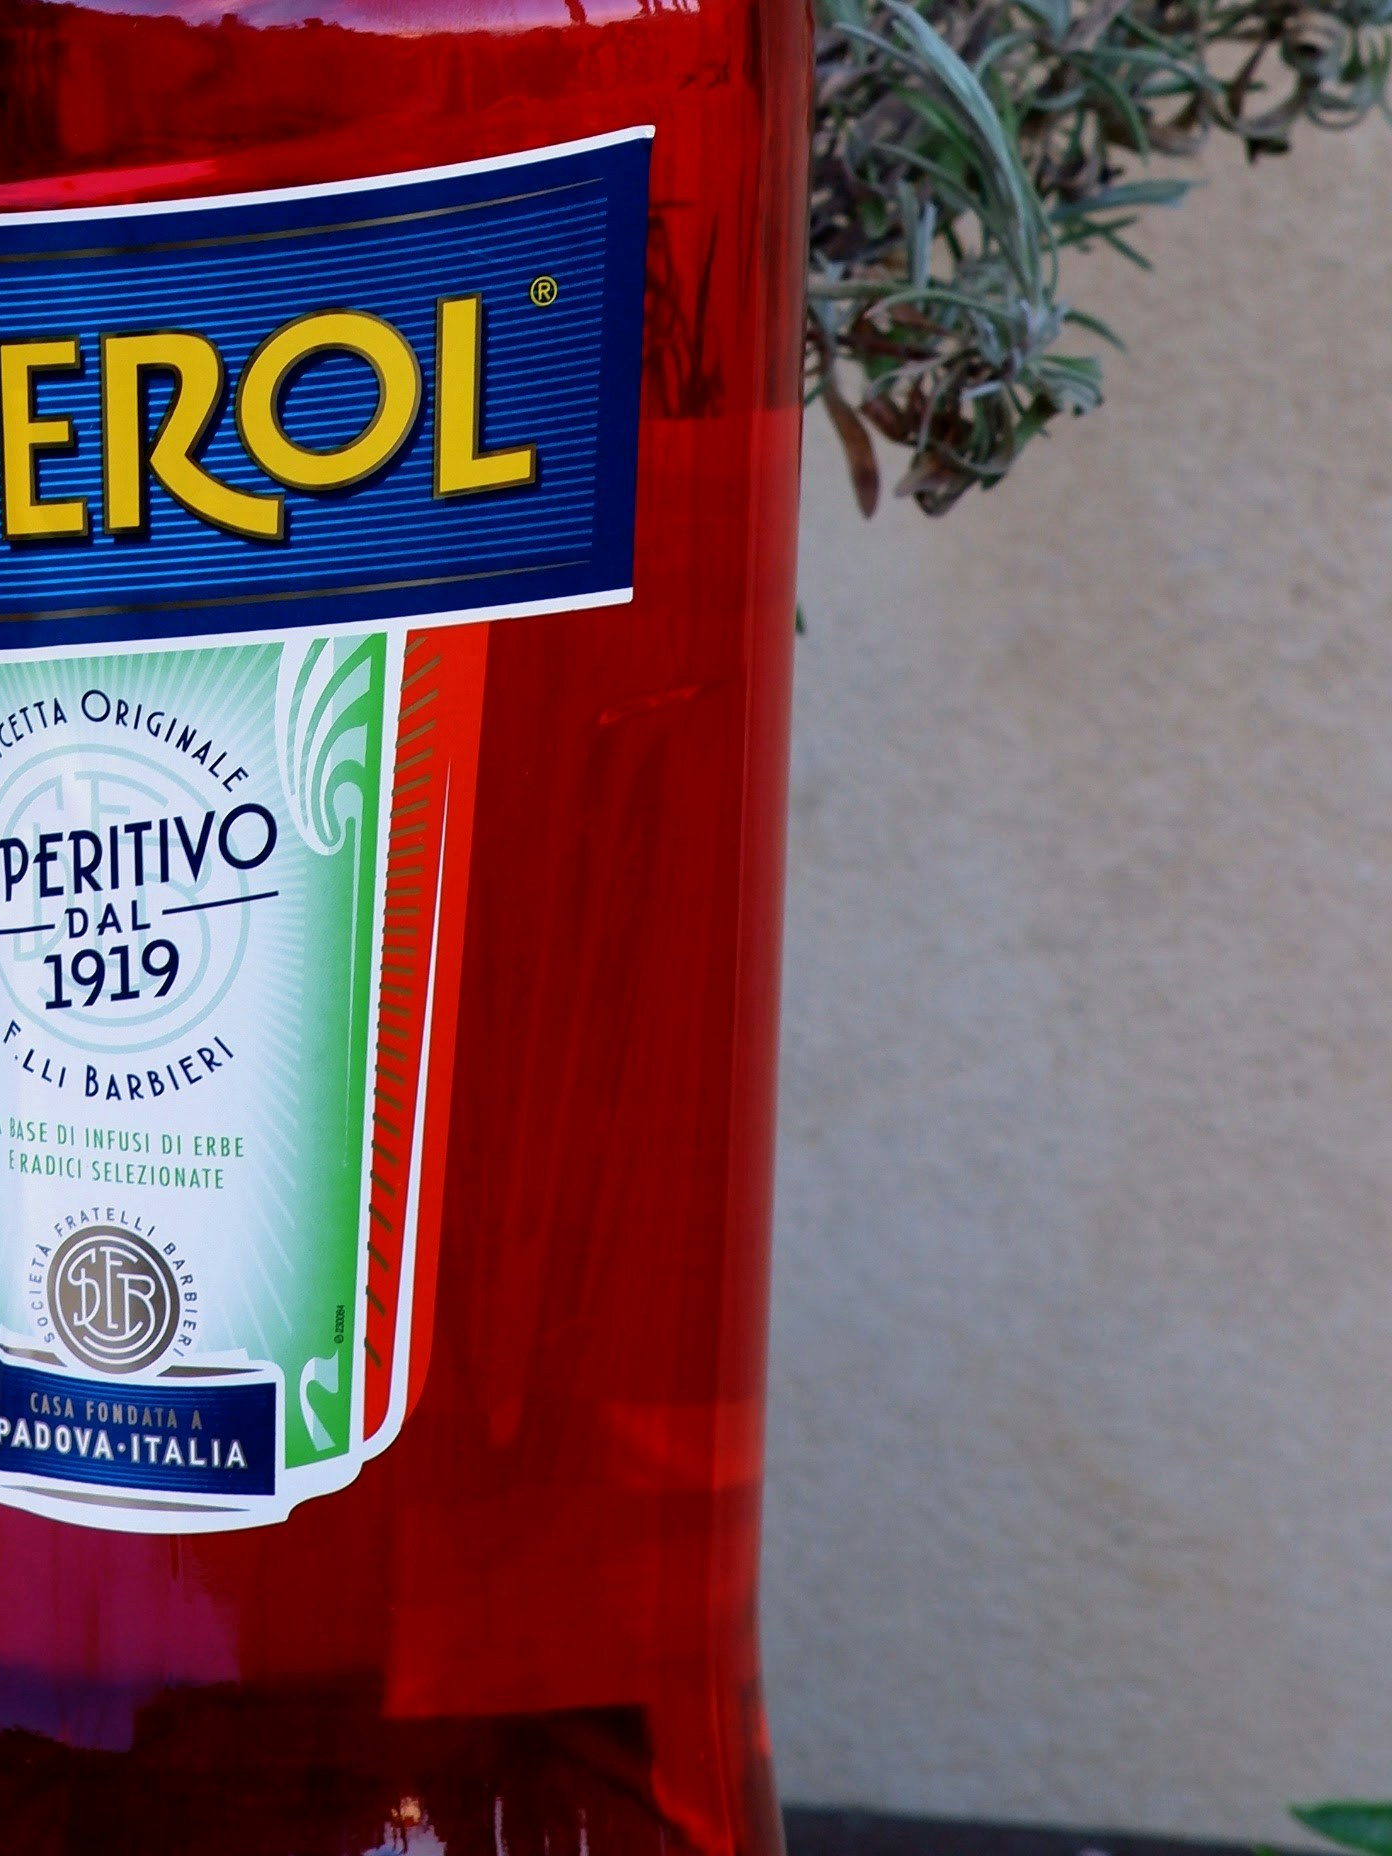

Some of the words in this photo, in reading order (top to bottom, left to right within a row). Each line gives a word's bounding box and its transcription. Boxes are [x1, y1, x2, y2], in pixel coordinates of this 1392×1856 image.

[81, 689, 249, 793] ORIGINALE
[65, 900, 151, 938] DAL
[44, 939, 179, 1010] 1919
[85, 1036, 234, 1101] BARBIERI
[9, 1116, 48, 1143] BASE
[57, 1124, 74, 1145] DI
[85, 1127, 149, 1153] INFUSI
[162, 1134, 181, 1155] DI
[194, 1135, 244, 1158] ERBE
[9, 1149, 14, 1170] E
[20, 1153, 82, 1179] RADICI
[92, 1160, 225, 1189] SELEZIONATE
[54, 1207, 156, 1237] FRATELLI
[163, 1242, 198, 1357] BARBIERI
[30, 1392, 74, 1419] CASA
[86, 1400, 177, 1429] FONDATA
[191, 1409, 203, 1430] A
